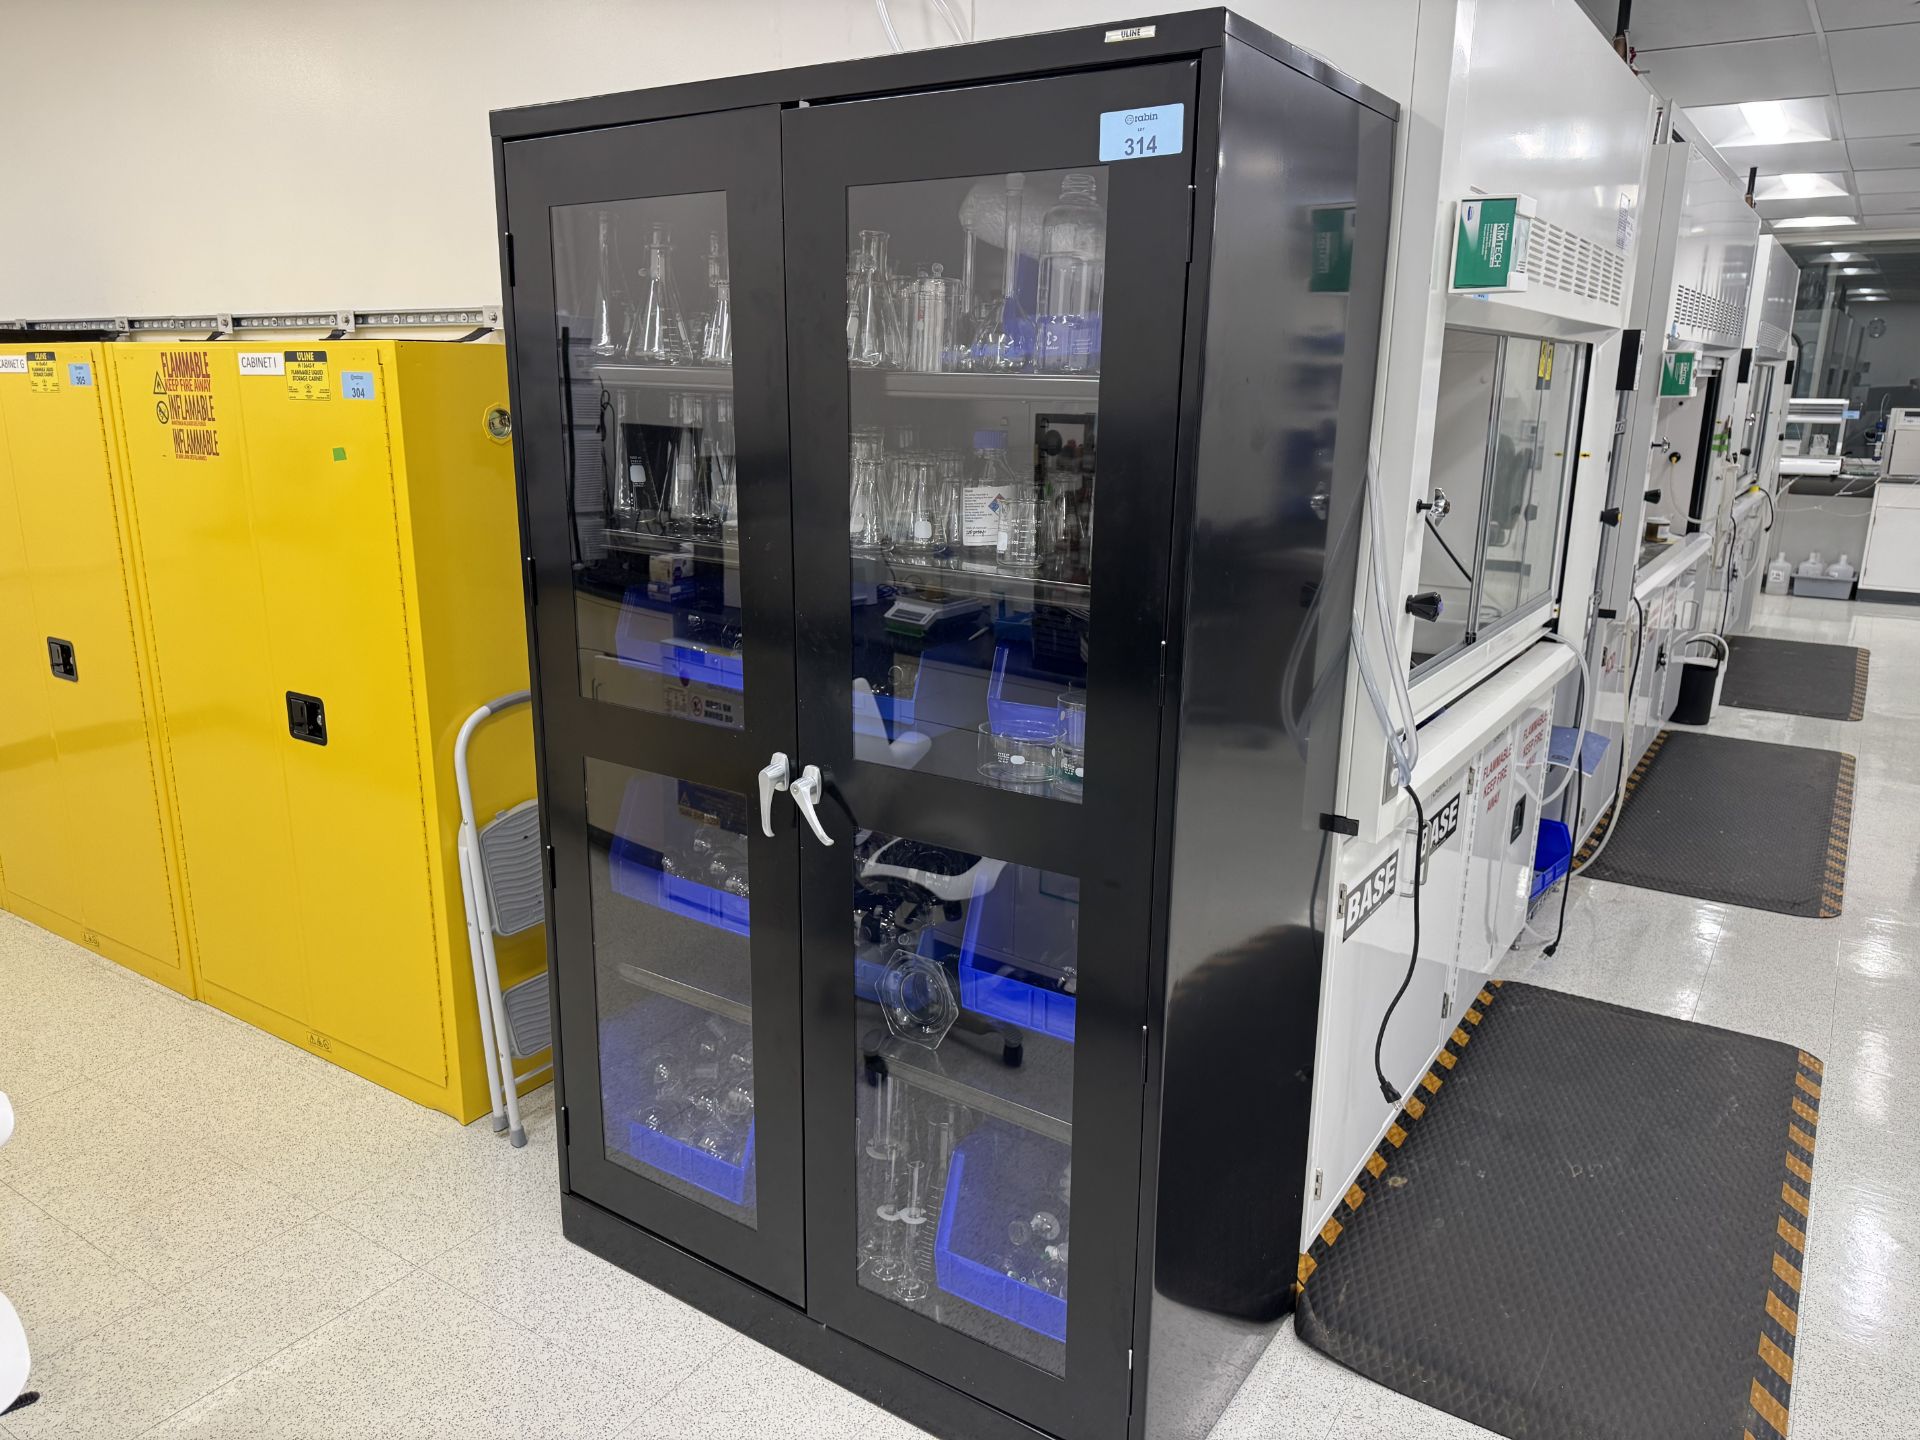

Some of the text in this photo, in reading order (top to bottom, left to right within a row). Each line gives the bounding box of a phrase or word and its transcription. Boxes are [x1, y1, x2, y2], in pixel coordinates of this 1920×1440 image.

[1120, 28, 1141, 38] ULINE
[1134, 112, 1158, 123] rabin
[1124, 135, 1158, 156] 314
[1493, 223, 1506, 268] KIMTECH
[241, 356, 272, 369] CABINET
[296, 351, 315, 361] ULINE
[160, 351, 211, 378] FLAMMABLE
[351, 387, 365, 398] 304
[1345, 856, 1397, 932] BASE
